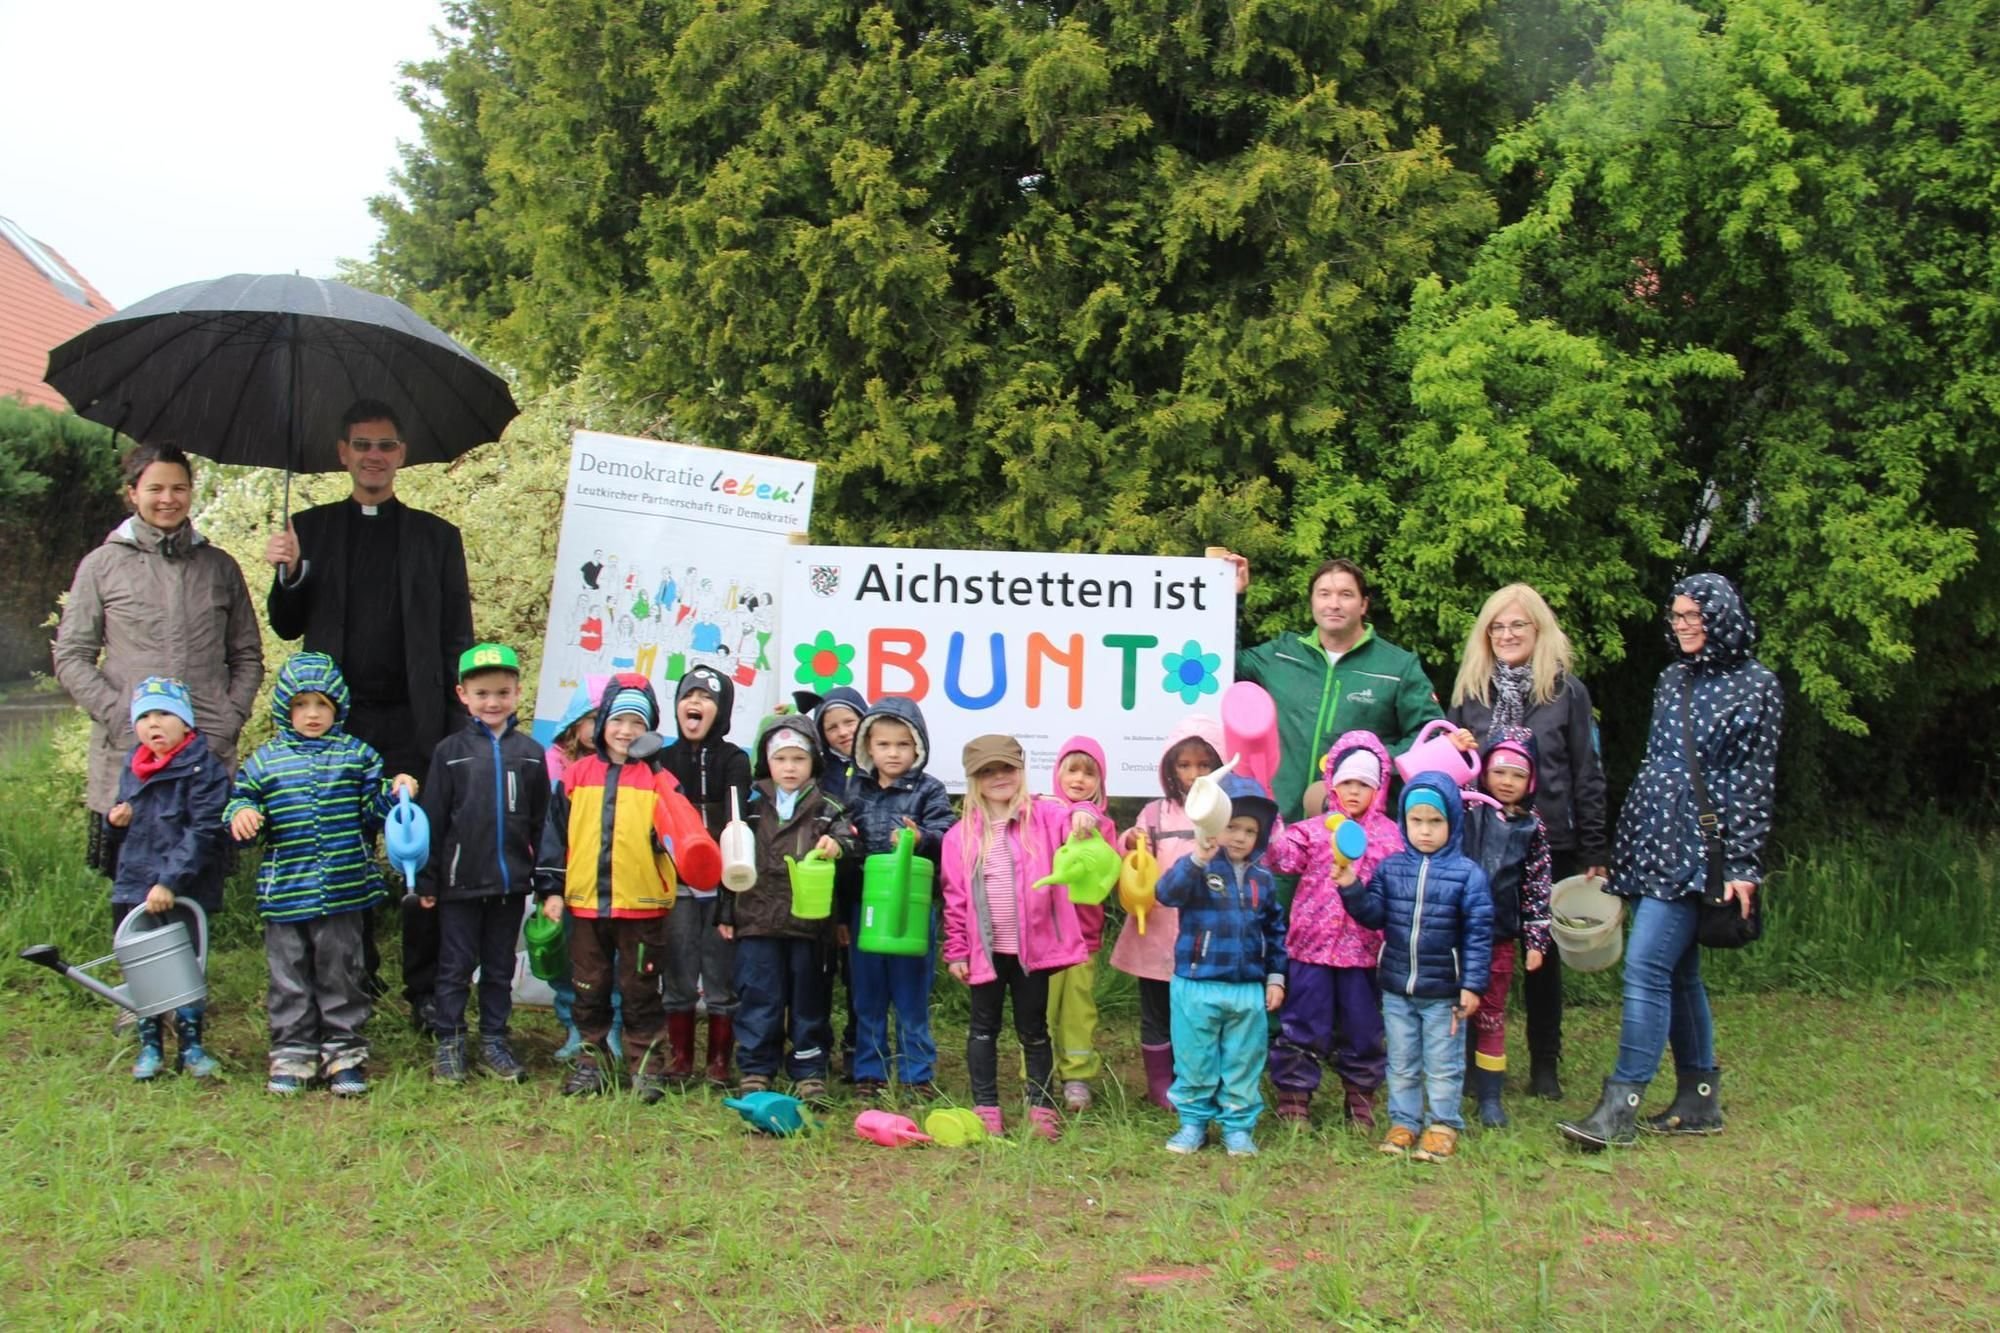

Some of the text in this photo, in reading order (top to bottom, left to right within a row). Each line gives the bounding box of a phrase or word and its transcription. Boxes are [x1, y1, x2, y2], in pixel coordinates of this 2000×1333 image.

[579, 452, 804, 503] Demokratie Leben!
[577, 484, 799, 526] Leutkircher Partnerschaft für Demokratie
[855, 563, 1207, 611] Aichstetten ist
[867, 628, 1159, 710] BUNT
